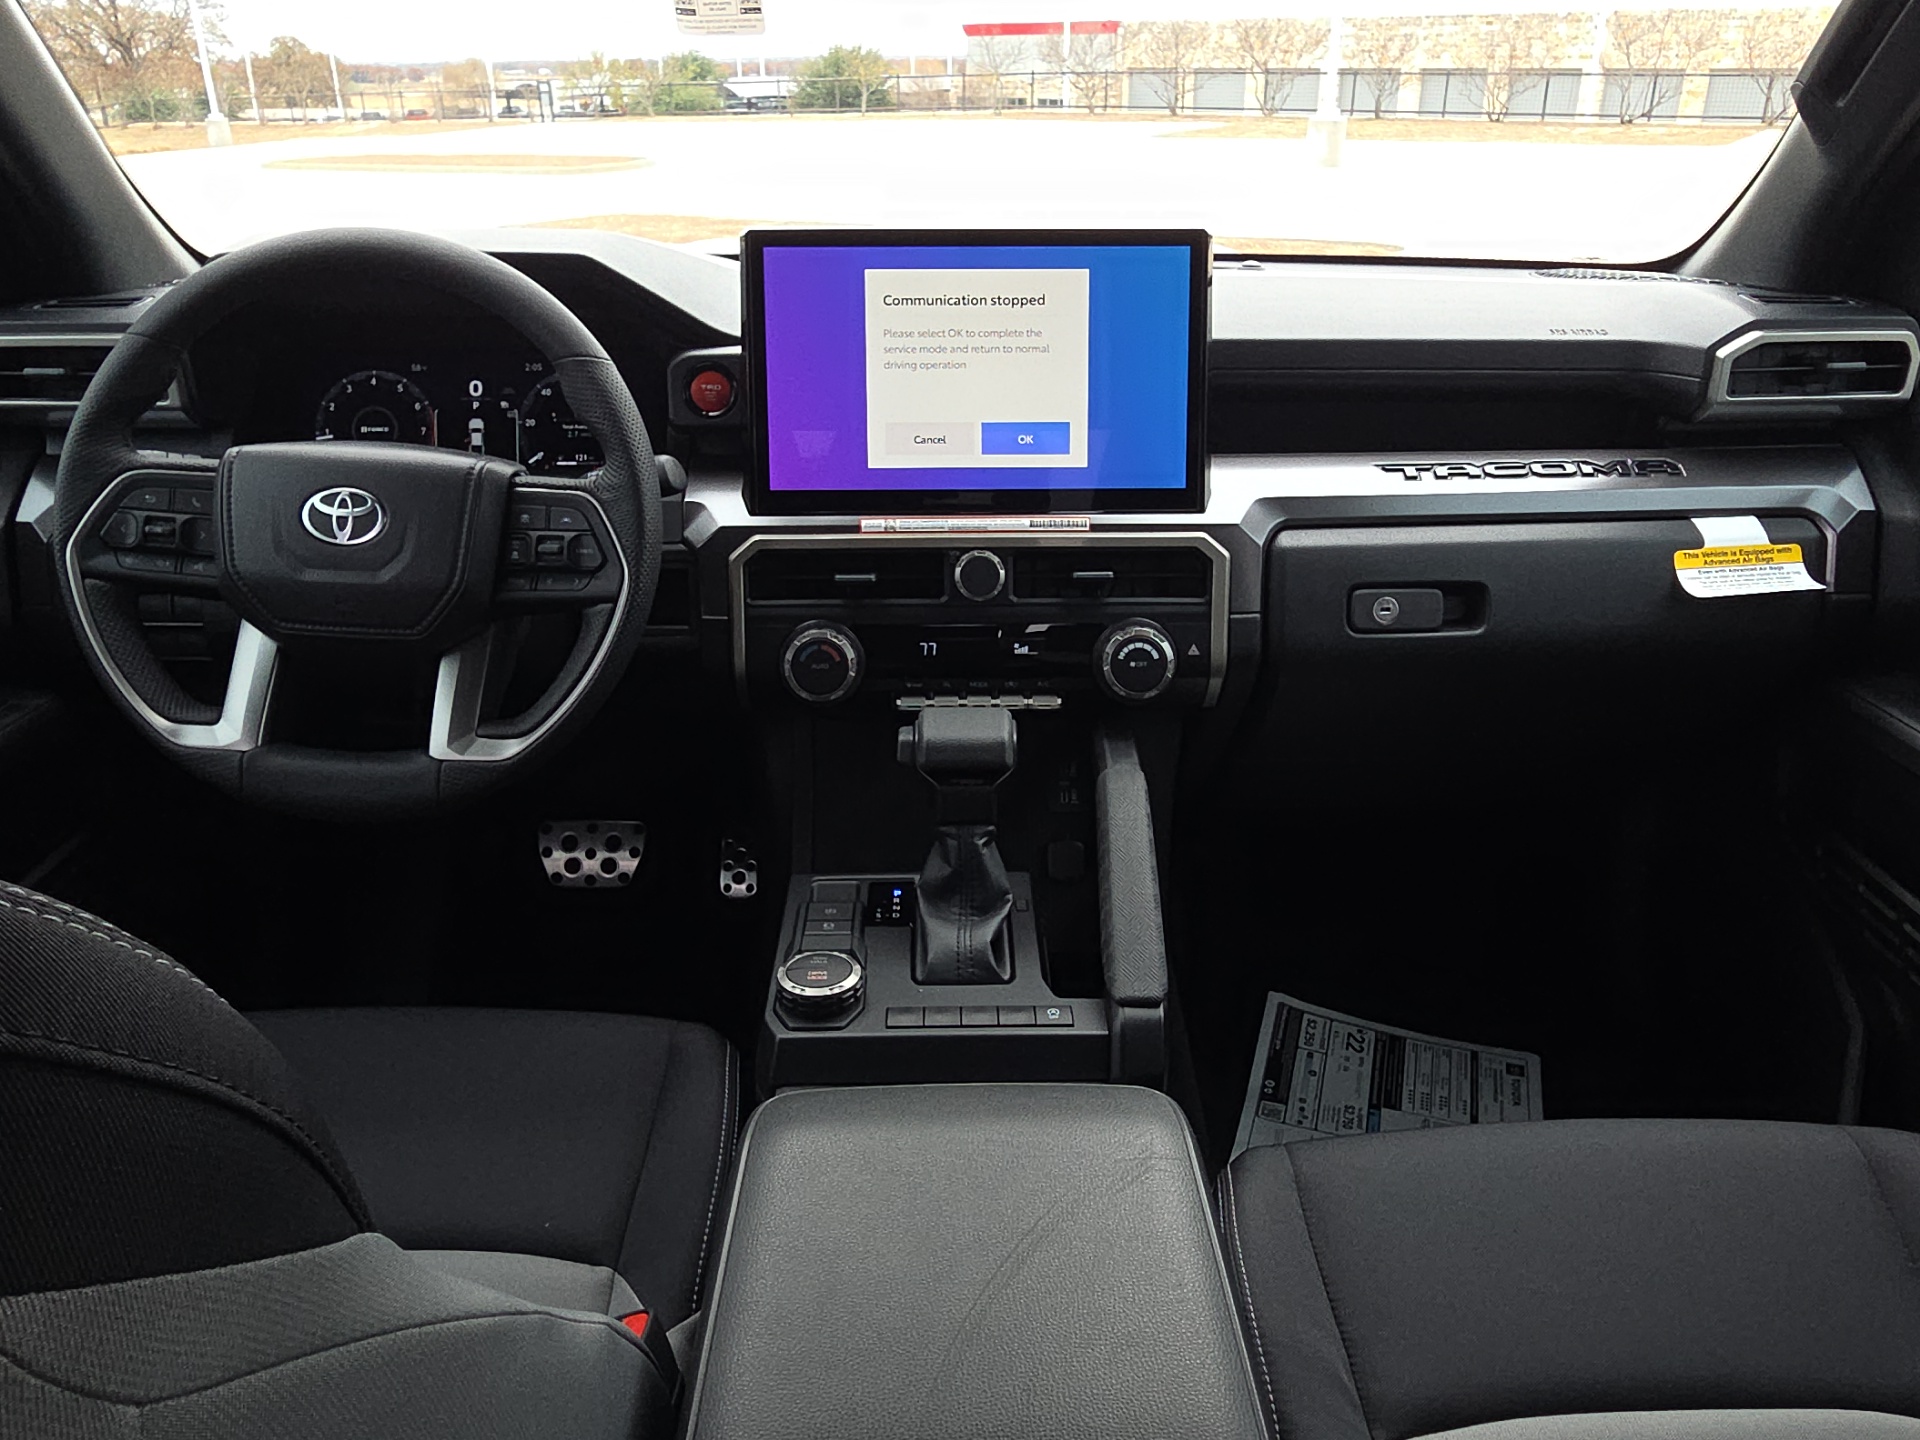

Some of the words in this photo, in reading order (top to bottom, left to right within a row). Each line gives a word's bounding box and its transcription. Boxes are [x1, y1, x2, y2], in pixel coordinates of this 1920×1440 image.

[883, 294, 987, 306] Communication
[990, 293, 1046, 309] stopped
[883, 329, 915, 338] Please
[917, 329, 946, 338] select
[947, 329, 964, 338] OK
[965, 329, 976, 338] to
[977, 328, 1024, 340] complete
[1026, 328, 1043, 338] the
[883, 345, 917, 354] service
[919, 344, 948, 354] mode
[949, 344, 969, 354] and
[971, 345, 1000, 354] return
[1002, 345, 1013, 354] to
[1015, 344, 1050, 354] normal
[883, 360, 917, 372] driving
[919, 361, 967, 371] operation
[370, 376, 377, 386] 4
[346, 384, 353, 393] 3
[396, 383, 404, 393] 5
[468, 379, 483, 397] 0
[540, 387, 552, 397] 40
[329, 401, 335, 411] 2
[414, 401, 421, 411] 6
[472, 401, 480, 410] P
[420, 427, 427, 436] 7
[913, 435, 947, 445] Cancel
[1017, 434, 1034, 445] OK
[1373, 458, 1687, 481] TACOMA
[1683, 552, 1699, 560] This
[1702, 550, 1728, 558] Vehicle
[1730, 549, 1737, 557] is
[1739, 547, 1774, 558] Equipped
[1776, 546, 1793, 554] with
[1703, 558, 1740, 566] Advanced
[1742, 556, 1753, 564] Air
[1755, 556, 1774, 565] Bags
[919, 642, 938, 657] 77
[1345, 1031, 1366, 1054] 22
